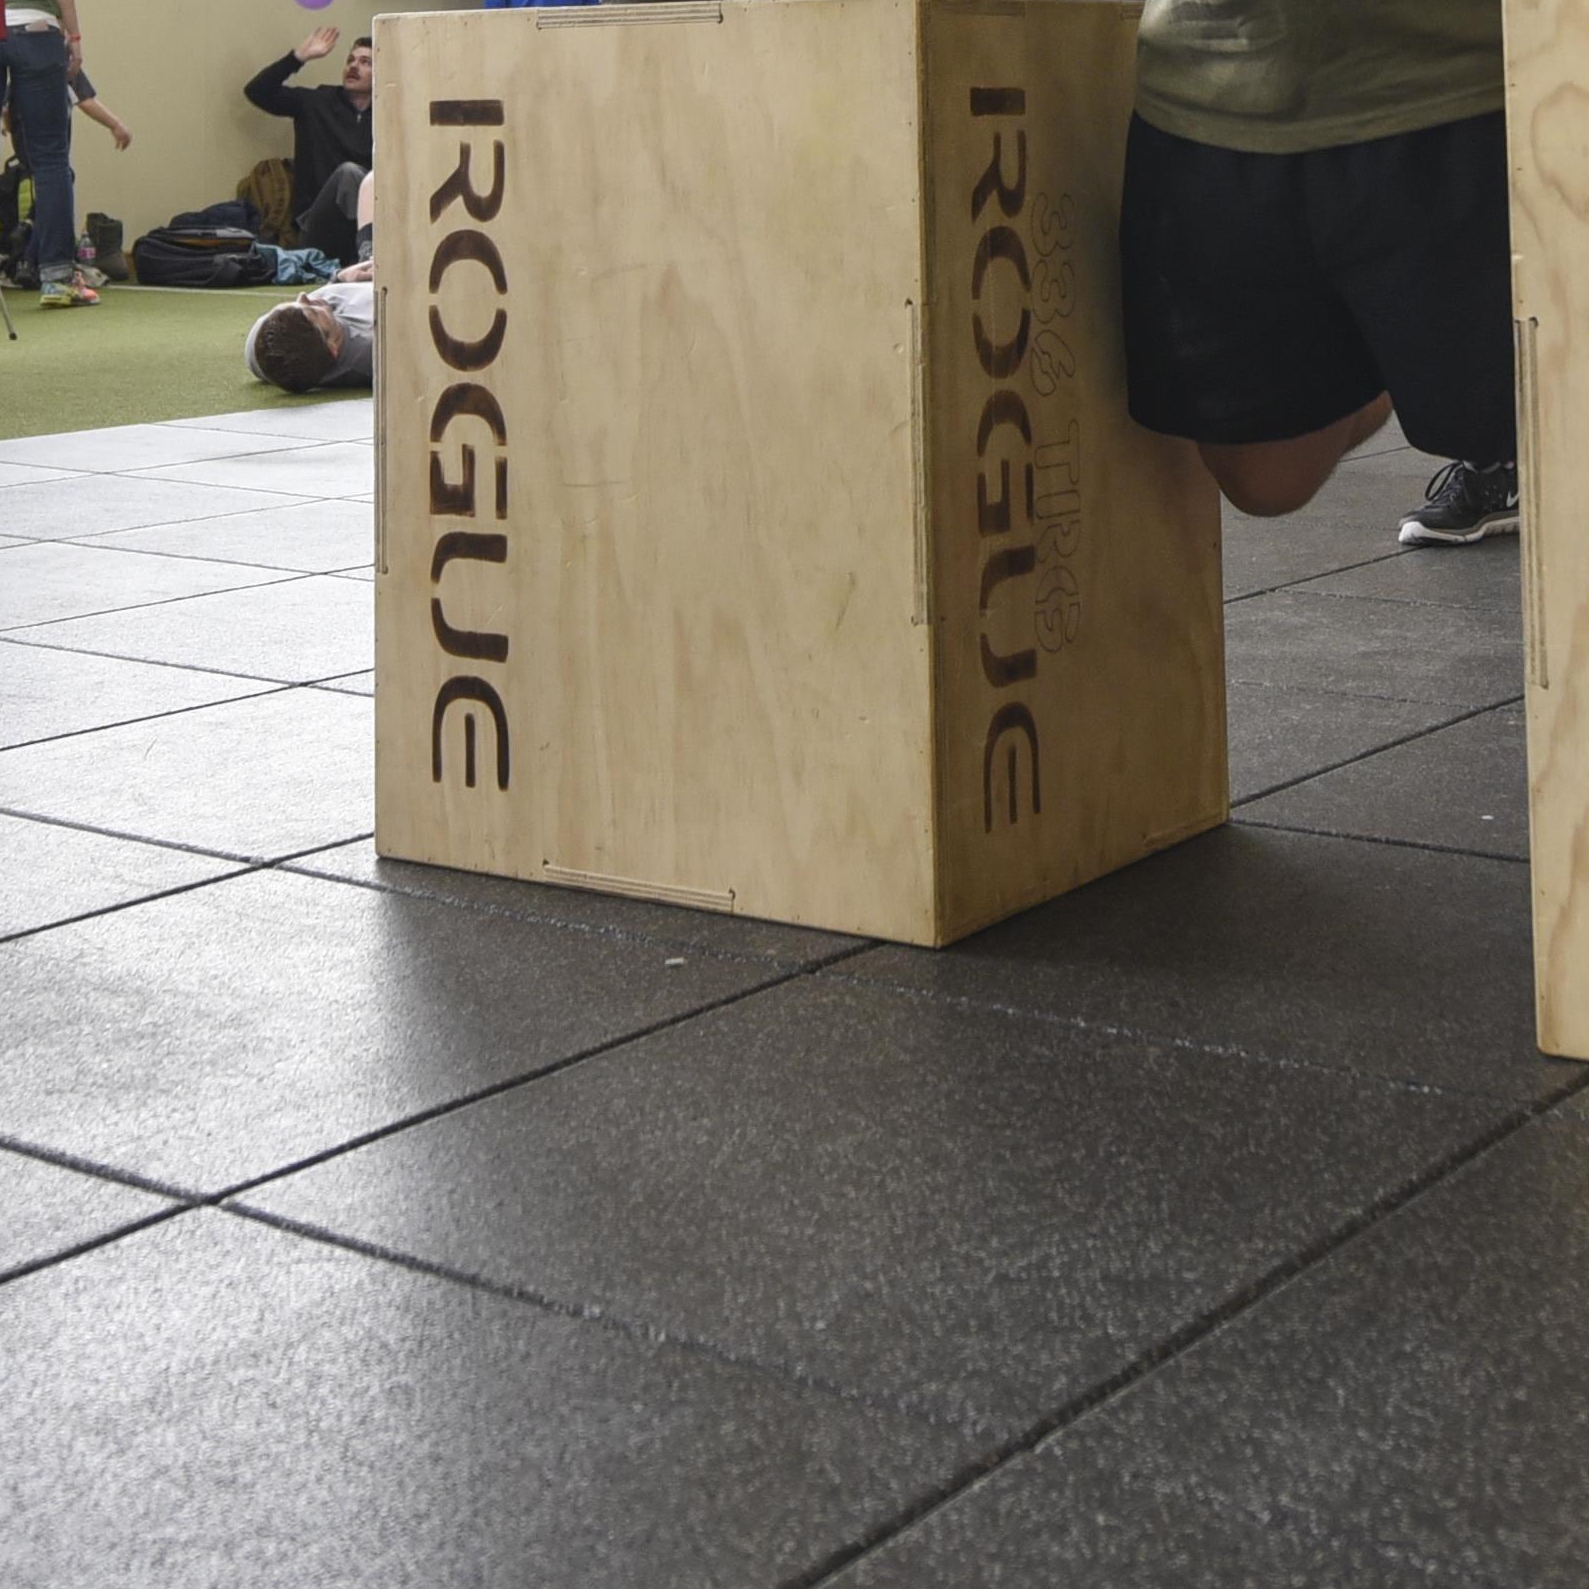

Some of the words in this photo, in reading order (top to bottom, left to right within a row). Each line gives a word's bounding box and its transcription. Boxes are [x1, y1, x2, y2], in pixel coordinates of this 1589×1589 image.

[428, 98, 511, 793] ROGUE
[968, 85, 1042, 836] ROGUE
[1030, 191, 1077, 398] 336
